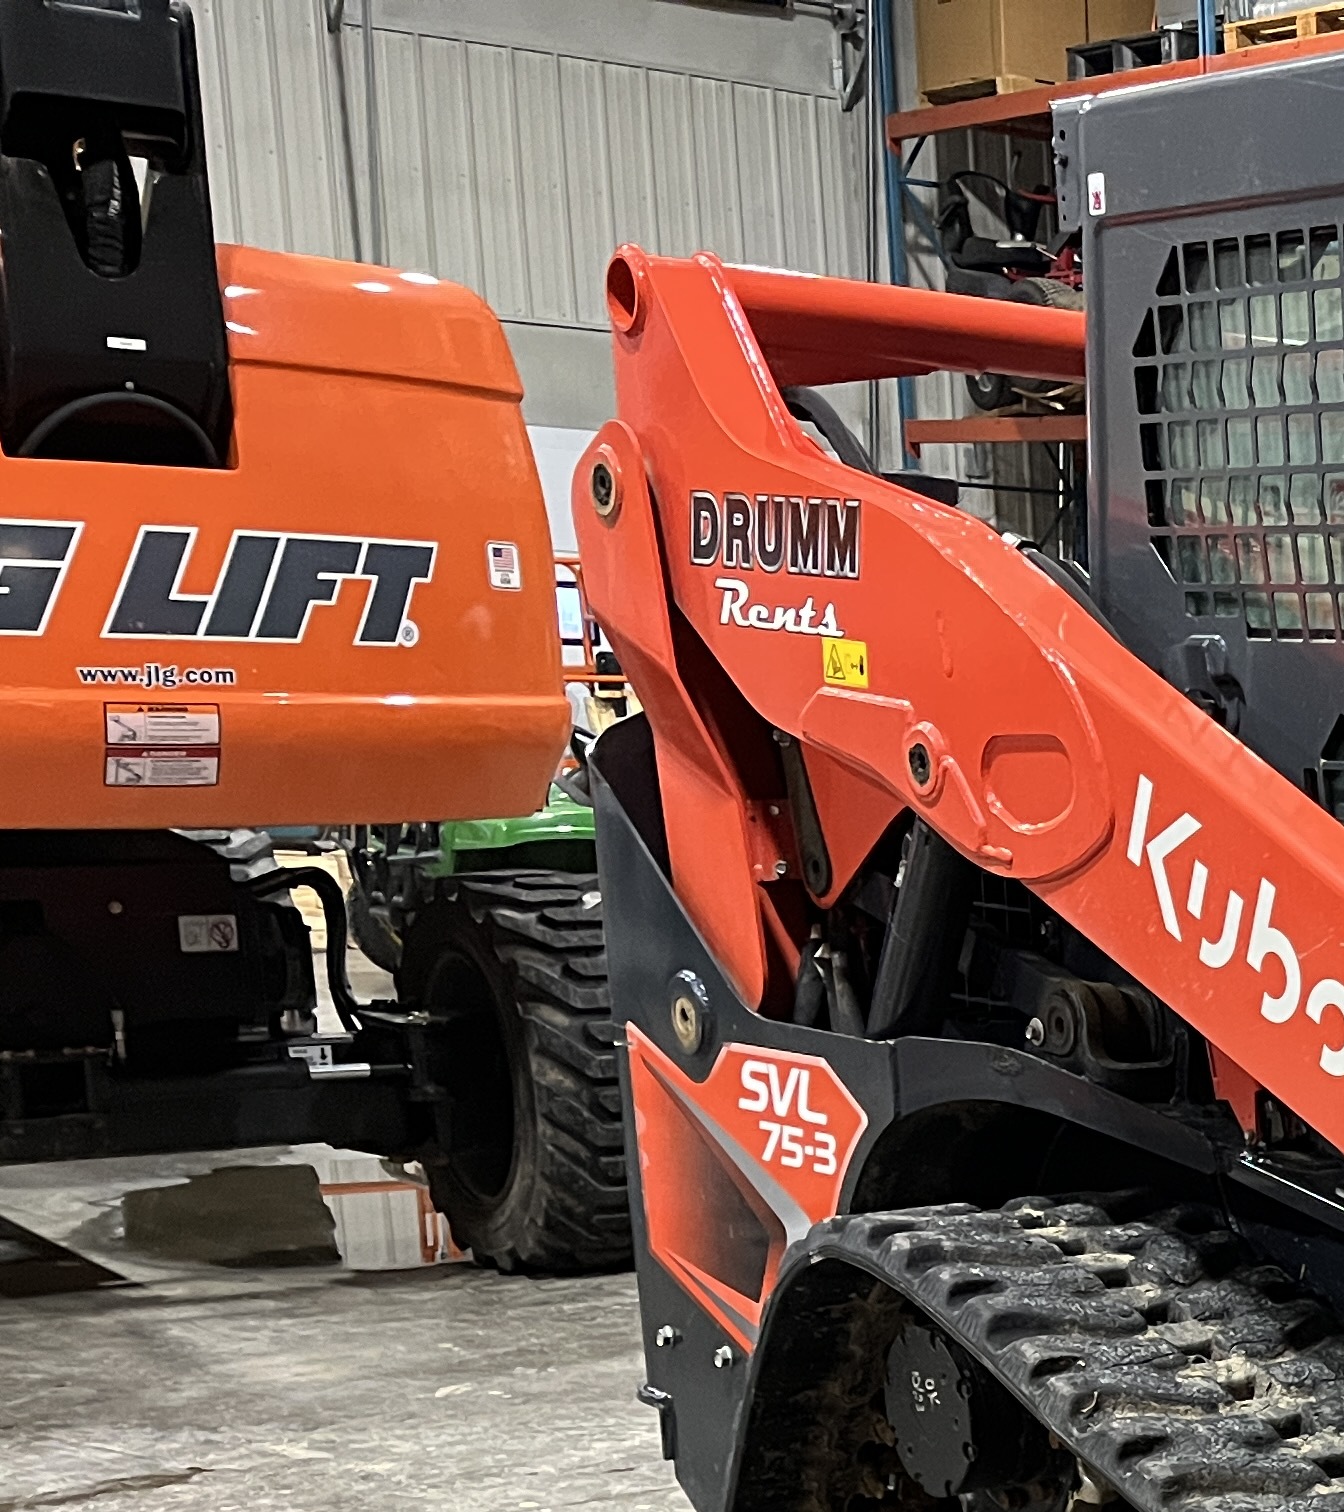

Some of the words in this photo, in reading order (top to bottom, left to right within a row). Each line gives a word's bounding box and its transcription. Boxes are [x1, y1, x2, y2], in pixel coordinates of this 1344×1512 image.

[690, 490, 861, 580] DRUMM
[100, 525, 438, 646] LIFT
[714, 578, 845, 637] Rents
[77, 663, 237, 690] www.jlg.com
[738, 1060, 828, 1126] SVL
[758, 1120, 837, 1176] 75-3
